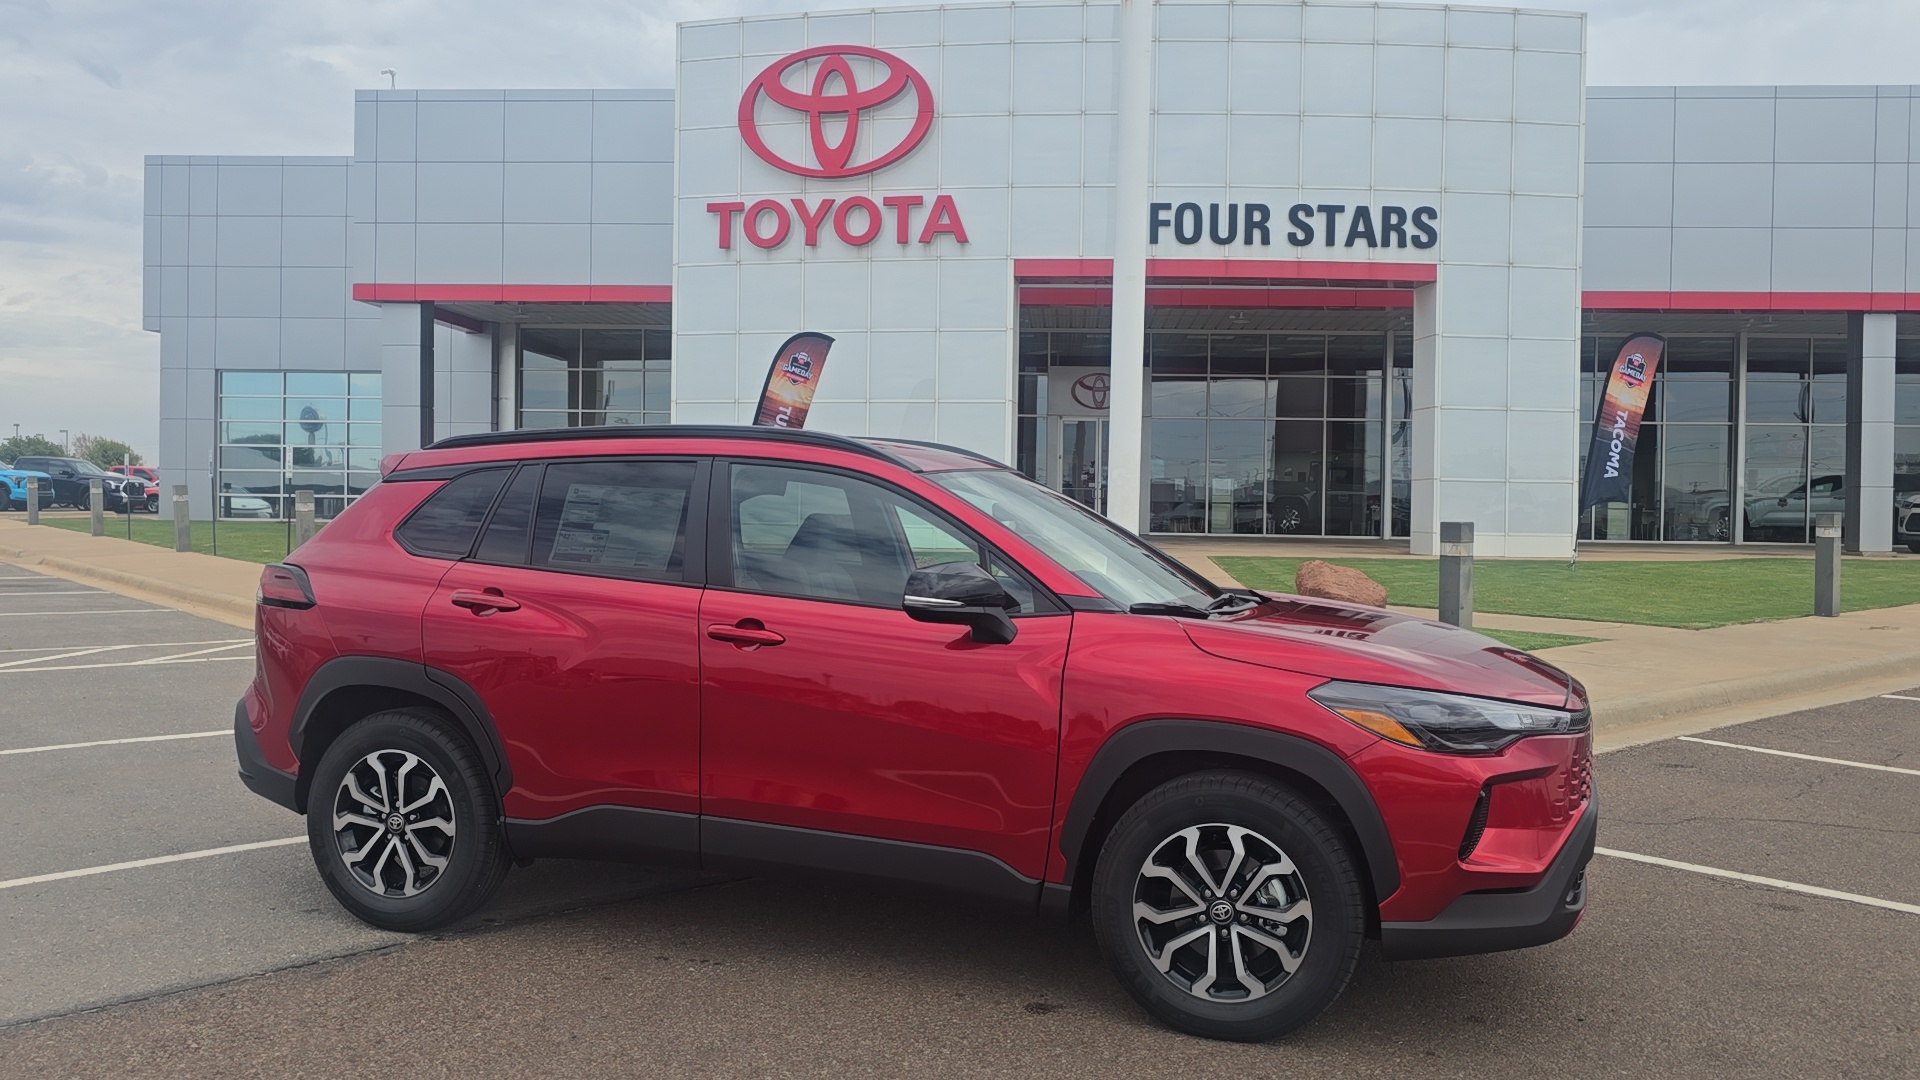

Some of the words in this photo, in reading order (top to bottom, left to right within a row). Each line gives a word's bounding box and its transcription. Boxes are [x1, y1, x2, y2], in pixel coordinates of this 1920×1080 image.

[706, 194, 969, 249] TOYOTA
[1149, 202, 1271, 246] FOUR
[1287, 203, 1438, 250] STARS
[782, 364, 813, 379] GAMEDAY
[1619, 365, 1647, 382] GAMEDAY
[774, 406, 792, 428] TU
[1604, 410, 1628, 478] TACOMA
